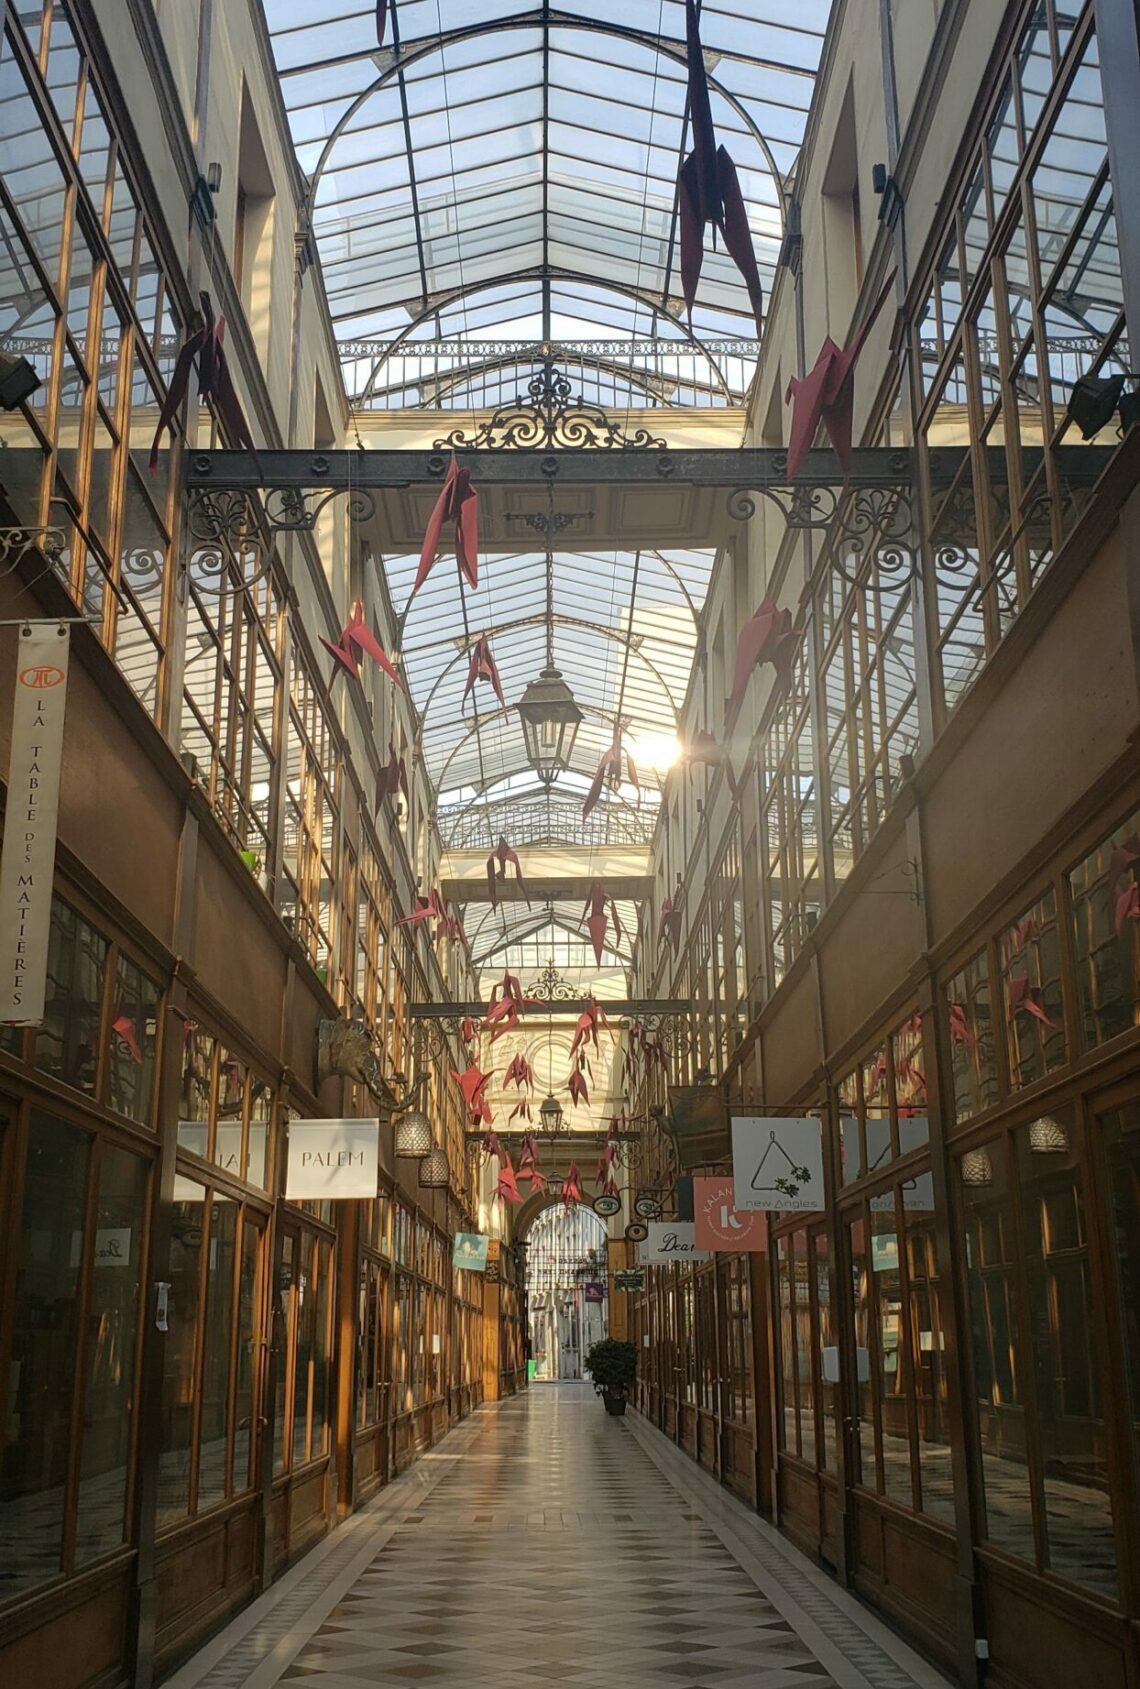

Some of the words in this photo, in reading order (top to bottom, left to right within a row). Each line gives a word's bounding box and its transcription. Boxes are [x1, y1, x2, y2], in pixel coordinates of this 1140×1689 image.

[32, 700, 45, 727] LA
[27, 746, 42, 821] TABLE
[25, 832, 35, 863] DES
[13, 875, 33, 1005] MATIÈRES
[302, 1151, 364, 1167] PALEM
[703, 1186, 733, 1213] KALAN
[745, 1200, 771, 1208] new
[774, 1200, 818, 1209] Angles
